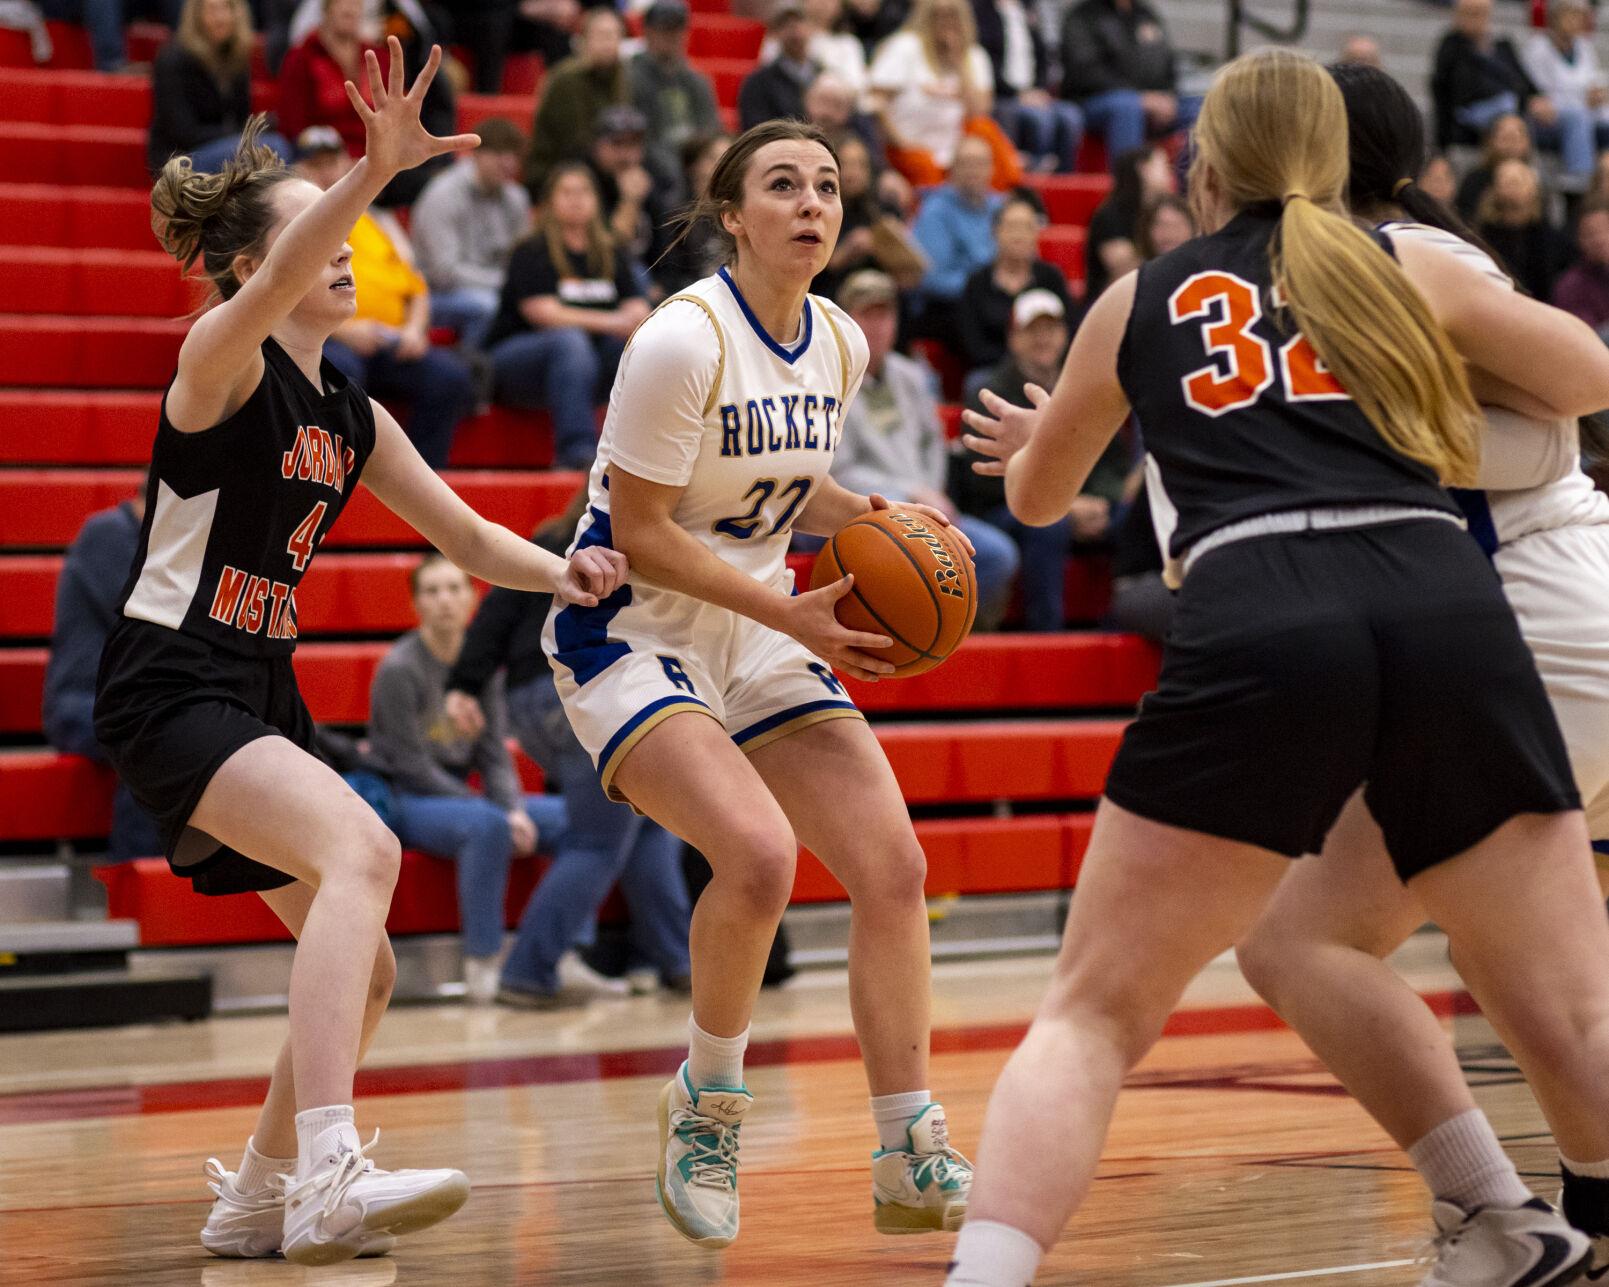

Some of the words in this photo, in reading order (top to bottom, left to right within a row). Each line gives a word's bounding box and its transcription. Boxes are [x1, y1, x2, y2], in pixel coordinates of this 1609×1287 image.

[719, 394, 842, 458] ROCKET
[287, 500, 328, 572] 4
[889, 513, 965, 600] Baden
